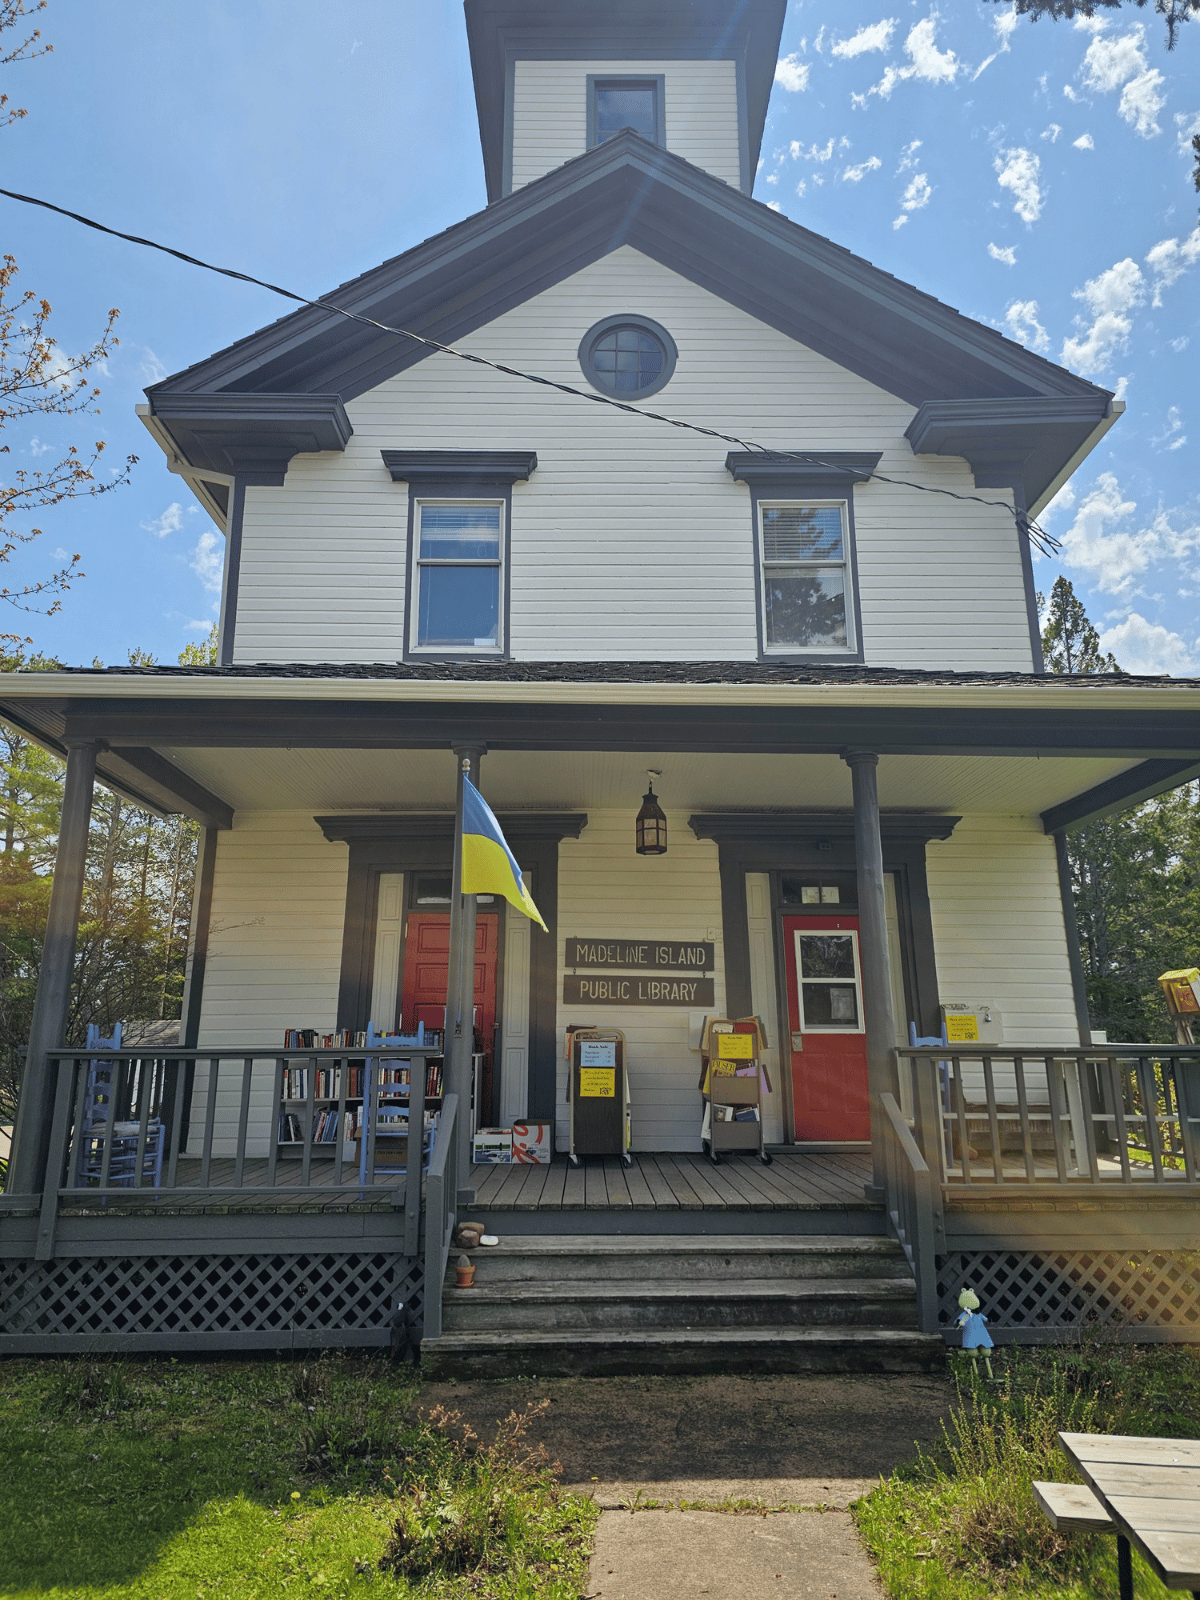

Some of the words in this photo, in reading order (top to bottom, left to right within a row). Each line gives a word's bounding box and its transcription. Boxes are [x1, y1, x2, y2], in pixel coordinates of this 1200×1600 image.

[576, 944, 648, 964] MADELINE
[655, 946, 706, 965] ISLAND
[580, 980, 630, 1000] PUBLIC
[638, 981, 697, 1001] LIBRARY
